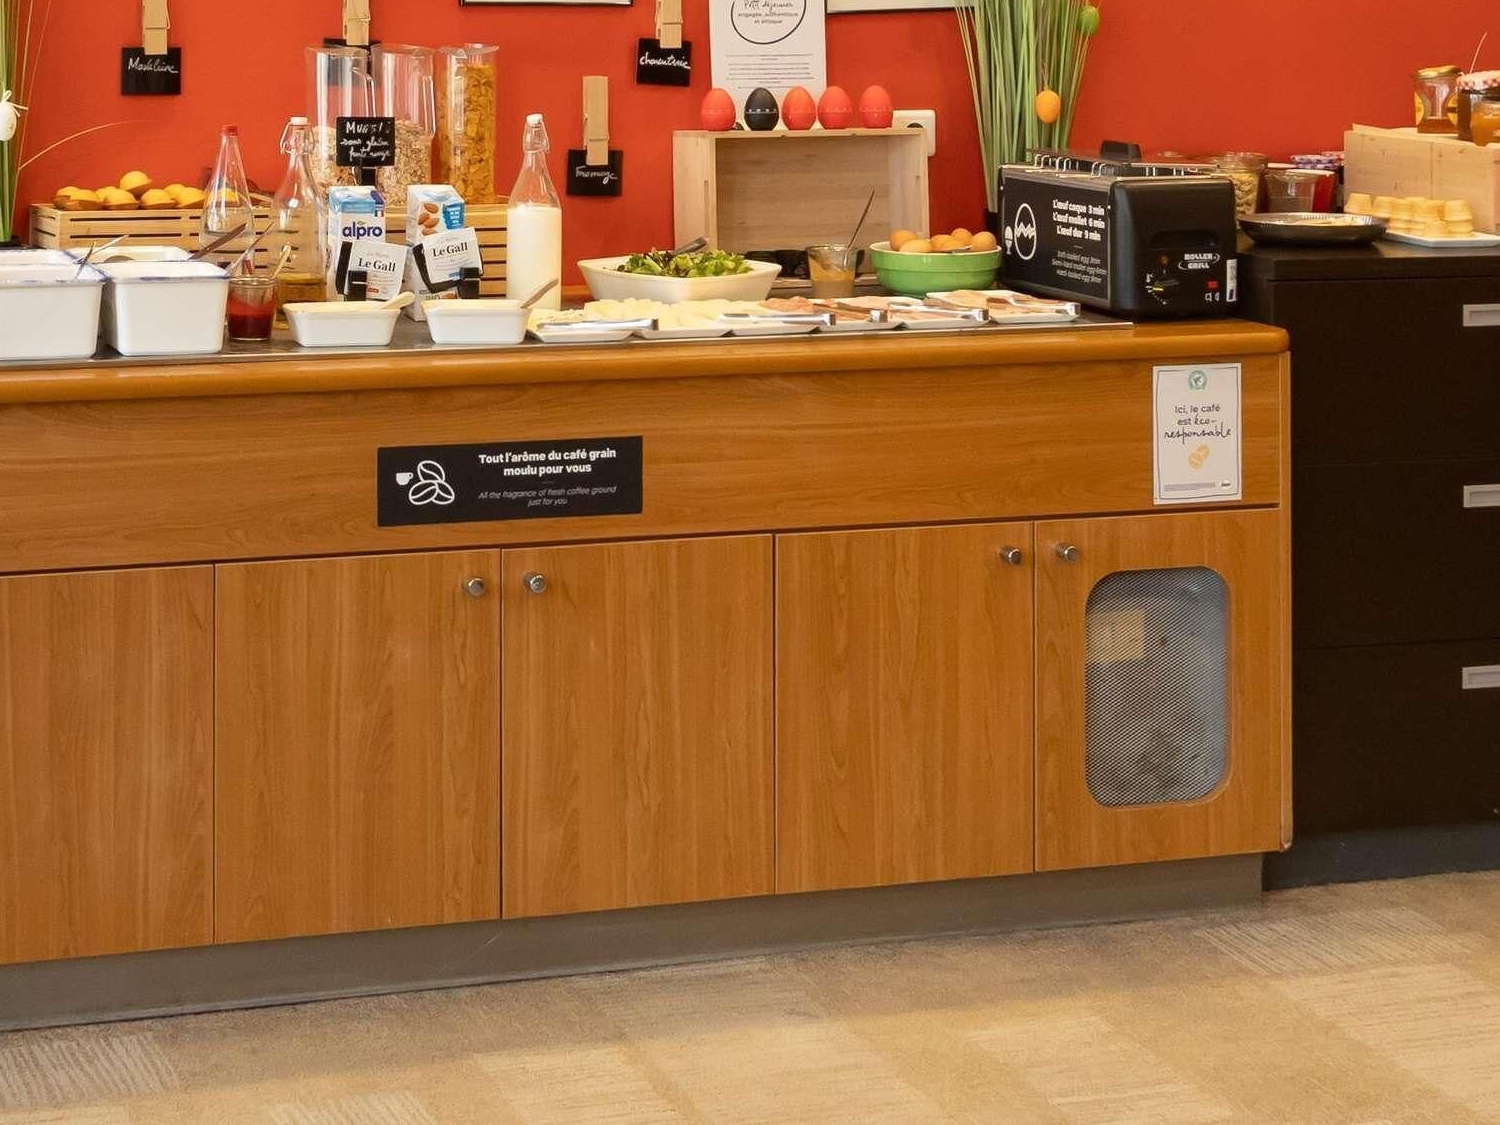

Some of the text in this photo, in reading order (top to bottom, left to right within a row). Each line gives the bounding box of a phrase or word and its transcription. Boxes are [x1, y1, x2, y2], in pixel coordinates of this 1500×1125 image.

[1092, 205, 1105, 216] min
[1093, 218, 1106, 229] min
[342, 221, 383, 239] alpro
[1089, 231, 1102, 242] min
[432, 241, 469, 258] Le Gall
[1184, 253, 1213, 261] ROLLER
[358, 257, 397, 273] Le Gall
[1200, 403, 1221, 413] café
[1164, 421, 1231, 445] responsable
[478, 448, 617, 464] Tout l'arôme du café grain
[503, 464, 592, 477] moulu pour vous
[553, 498, 568, 507] you
